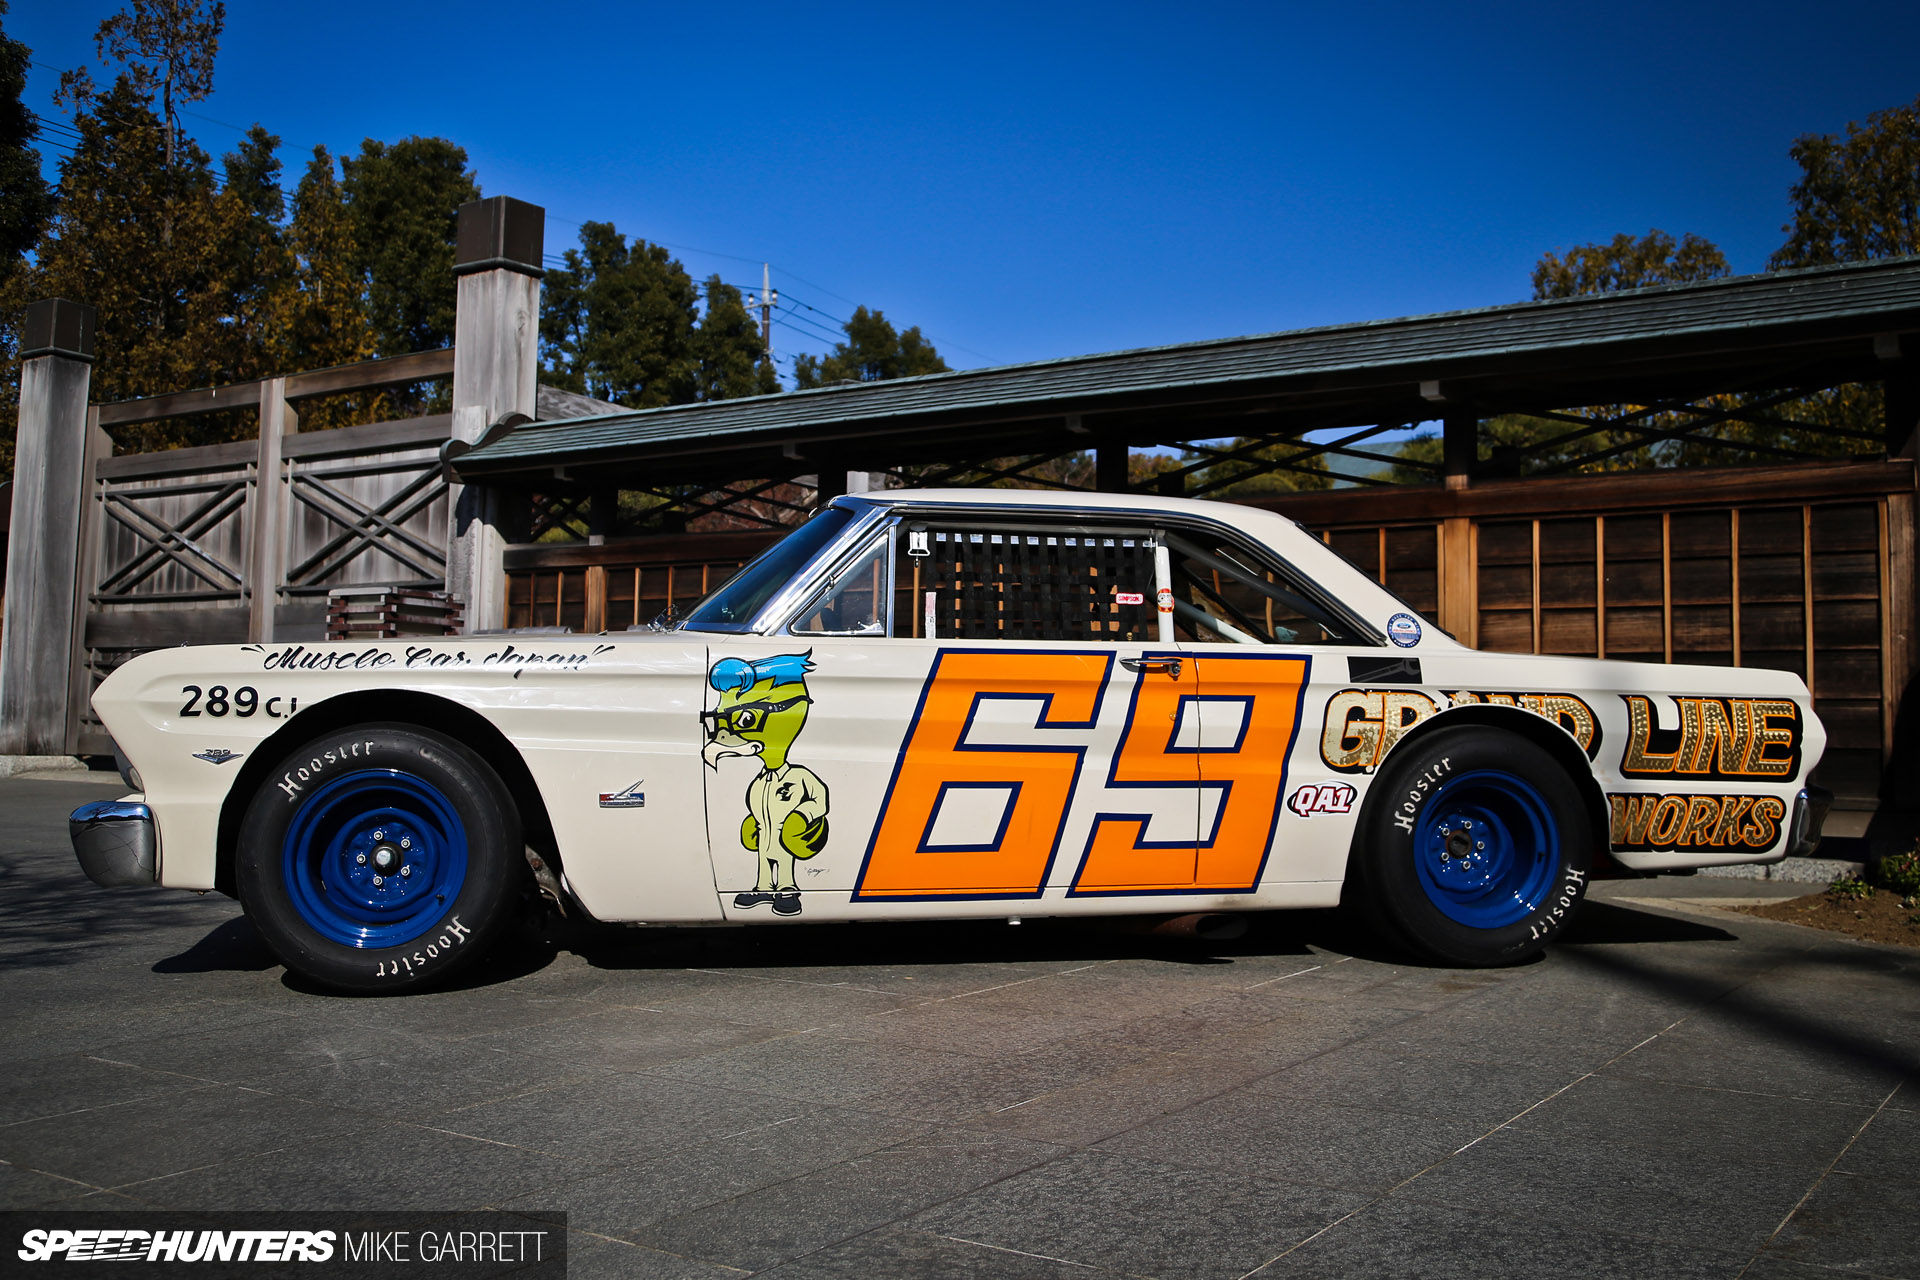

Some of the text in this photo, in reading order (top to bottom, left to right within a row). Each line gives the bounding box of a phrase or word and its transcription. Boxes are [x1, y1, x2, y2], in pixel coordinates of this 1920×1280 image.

[180, 685, 259, 718] 289
[1320, 689, 1797, 777] GRD LINE
[278, 741, 375, 802] Hoosier
[850, 648, 1313, 902] 69
[1294, 784, 1353, 818] QA1
[1394, 757, 1452, 835] Hoosier
[1609, 795, 1784, 847] WORKS
[1531, 863, 1585, 940] Hoosier
[376, 915, 471, 977] Hoosier
